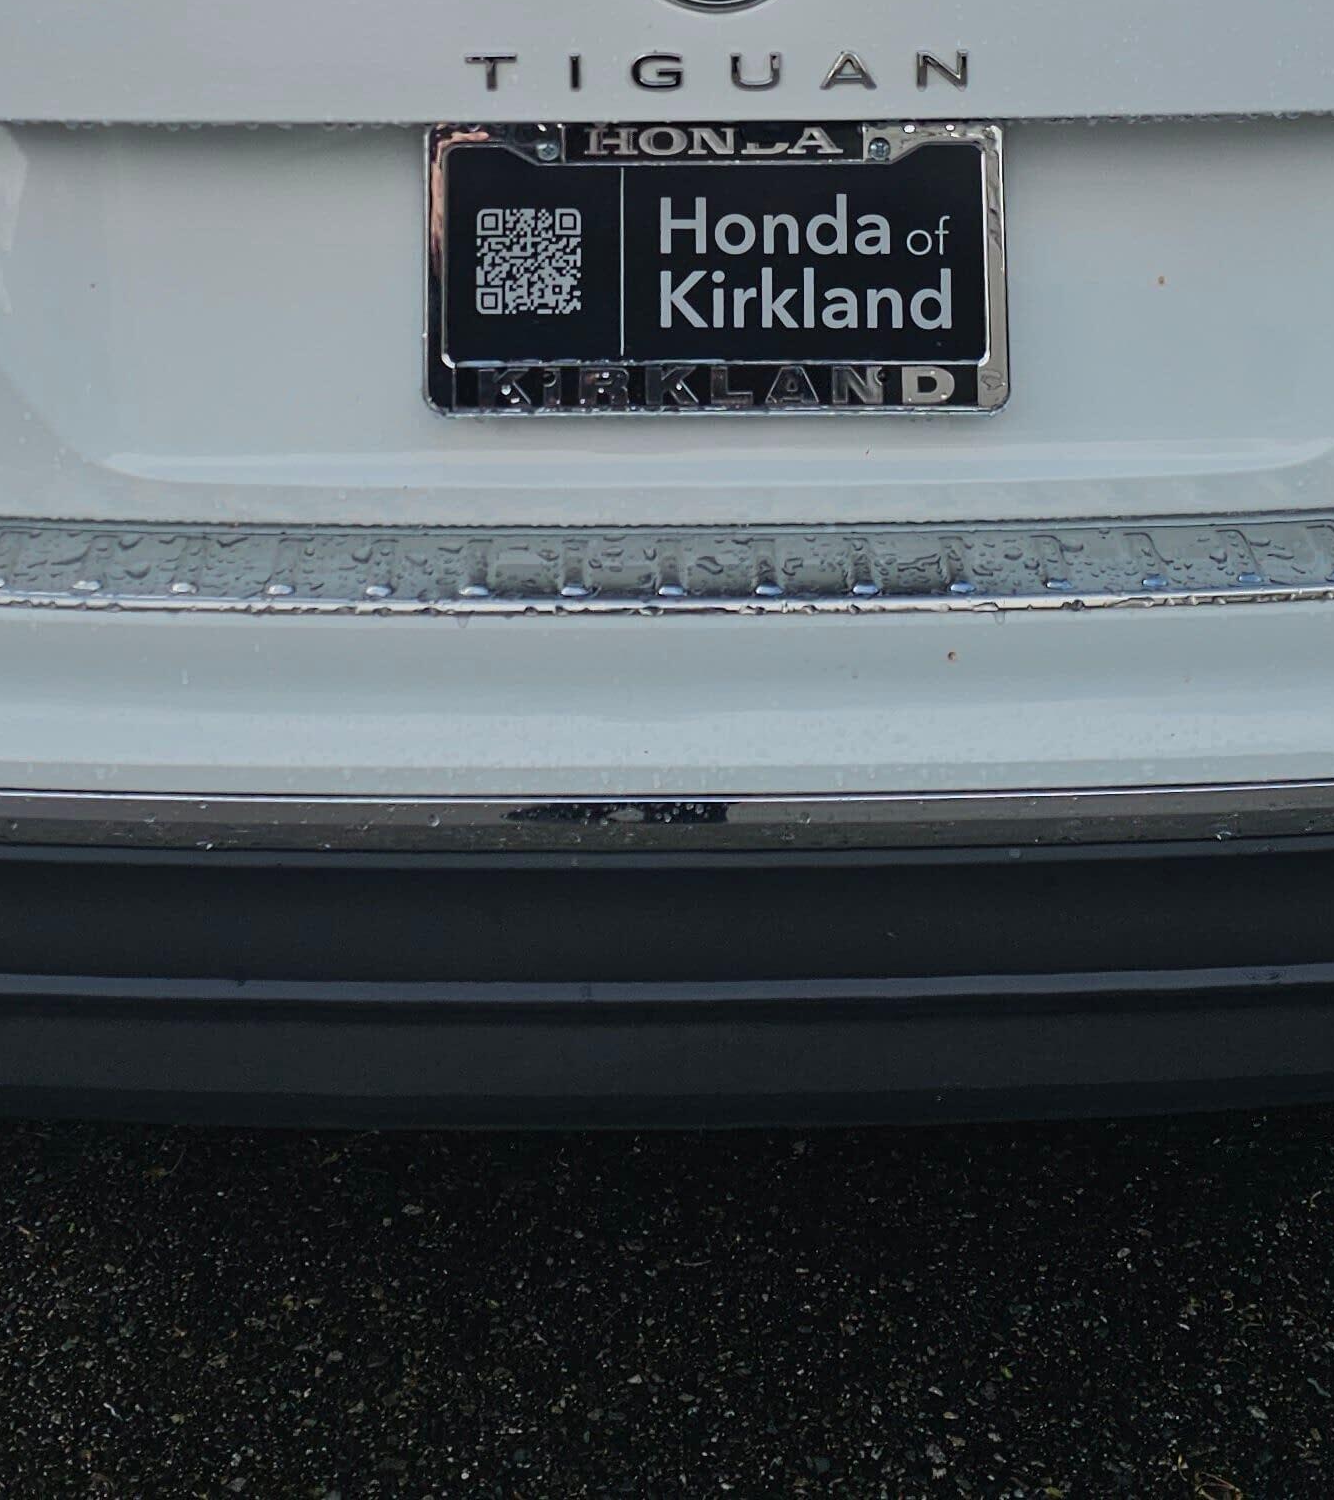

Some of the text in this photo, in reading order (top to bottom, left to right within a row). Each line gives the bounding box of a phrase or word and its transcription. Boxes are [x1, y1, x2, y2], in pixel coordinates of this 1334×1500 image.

[465, 49, 969, 92] TIGUAN
[659, 193, 950, 256] Honda of
[659, 267, 953, 331] Kirkland
[477, 365, 957, 407] KIRKLAND
